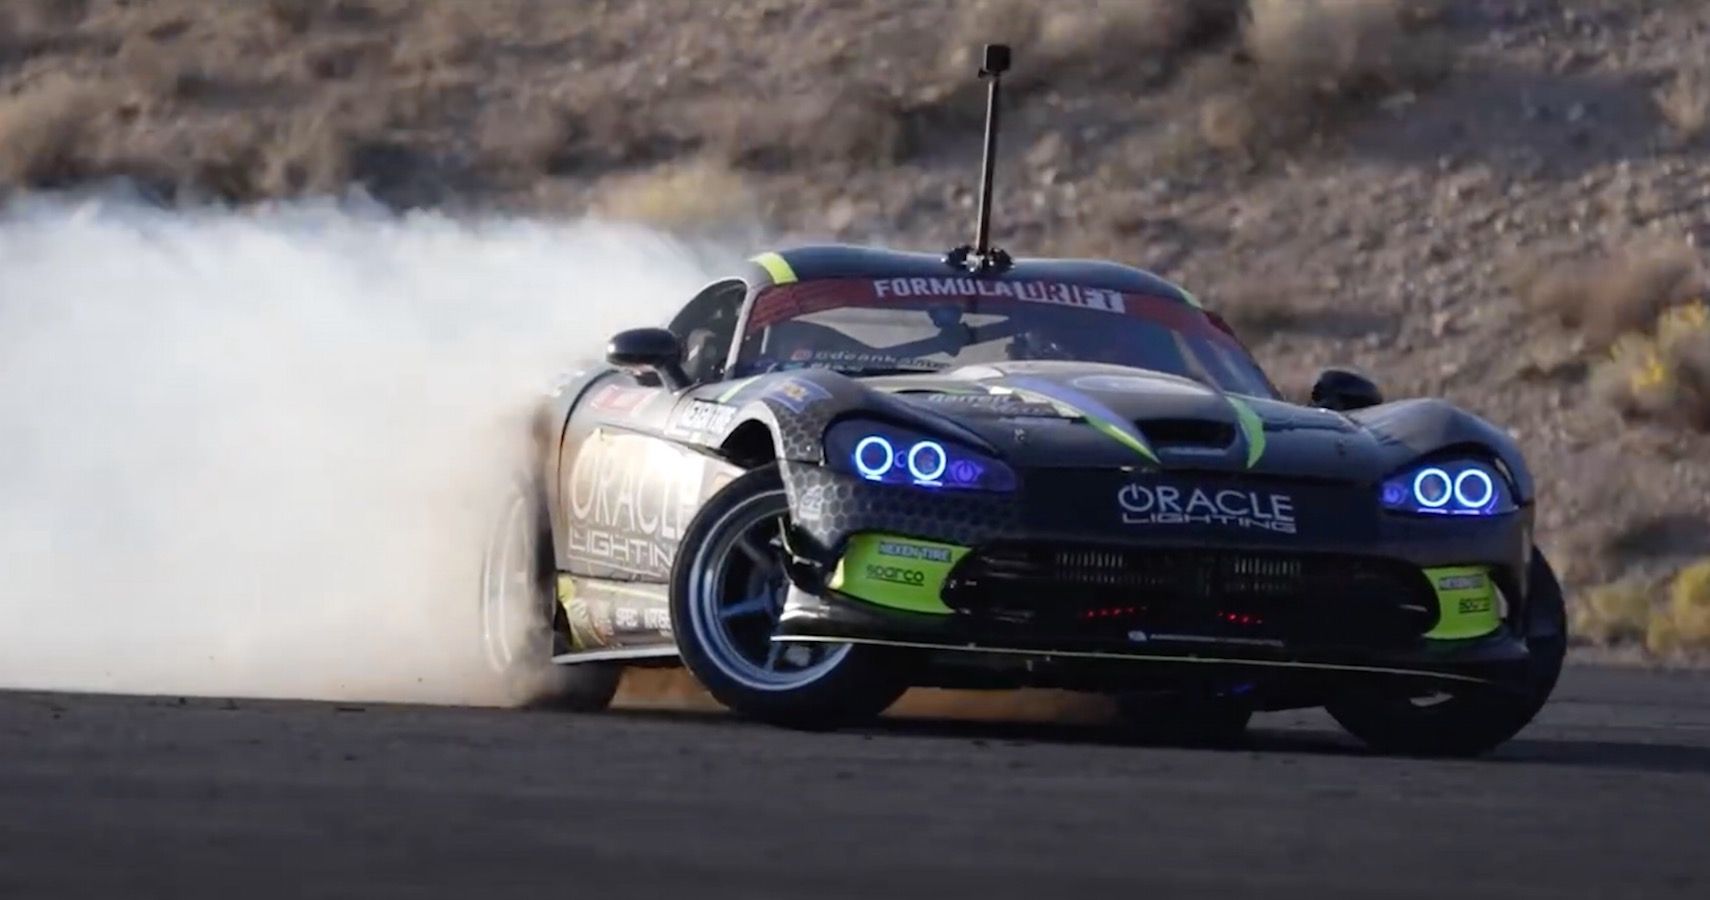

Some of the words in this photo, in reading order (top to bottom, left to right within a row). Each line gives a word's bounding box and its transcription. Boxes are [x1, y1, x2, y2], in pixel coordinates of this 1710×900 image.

[873, 278, 1013, 298] FORMULA
[1014, 281, 1125, 313] DRIFT
[1118, 483, 1295, 523] ORACLE
[1122, 512, 1296, 534] LIGHTING
[568, 526, 676, 568] LIGHTIN
[866, 564, 925, 586] sparco
